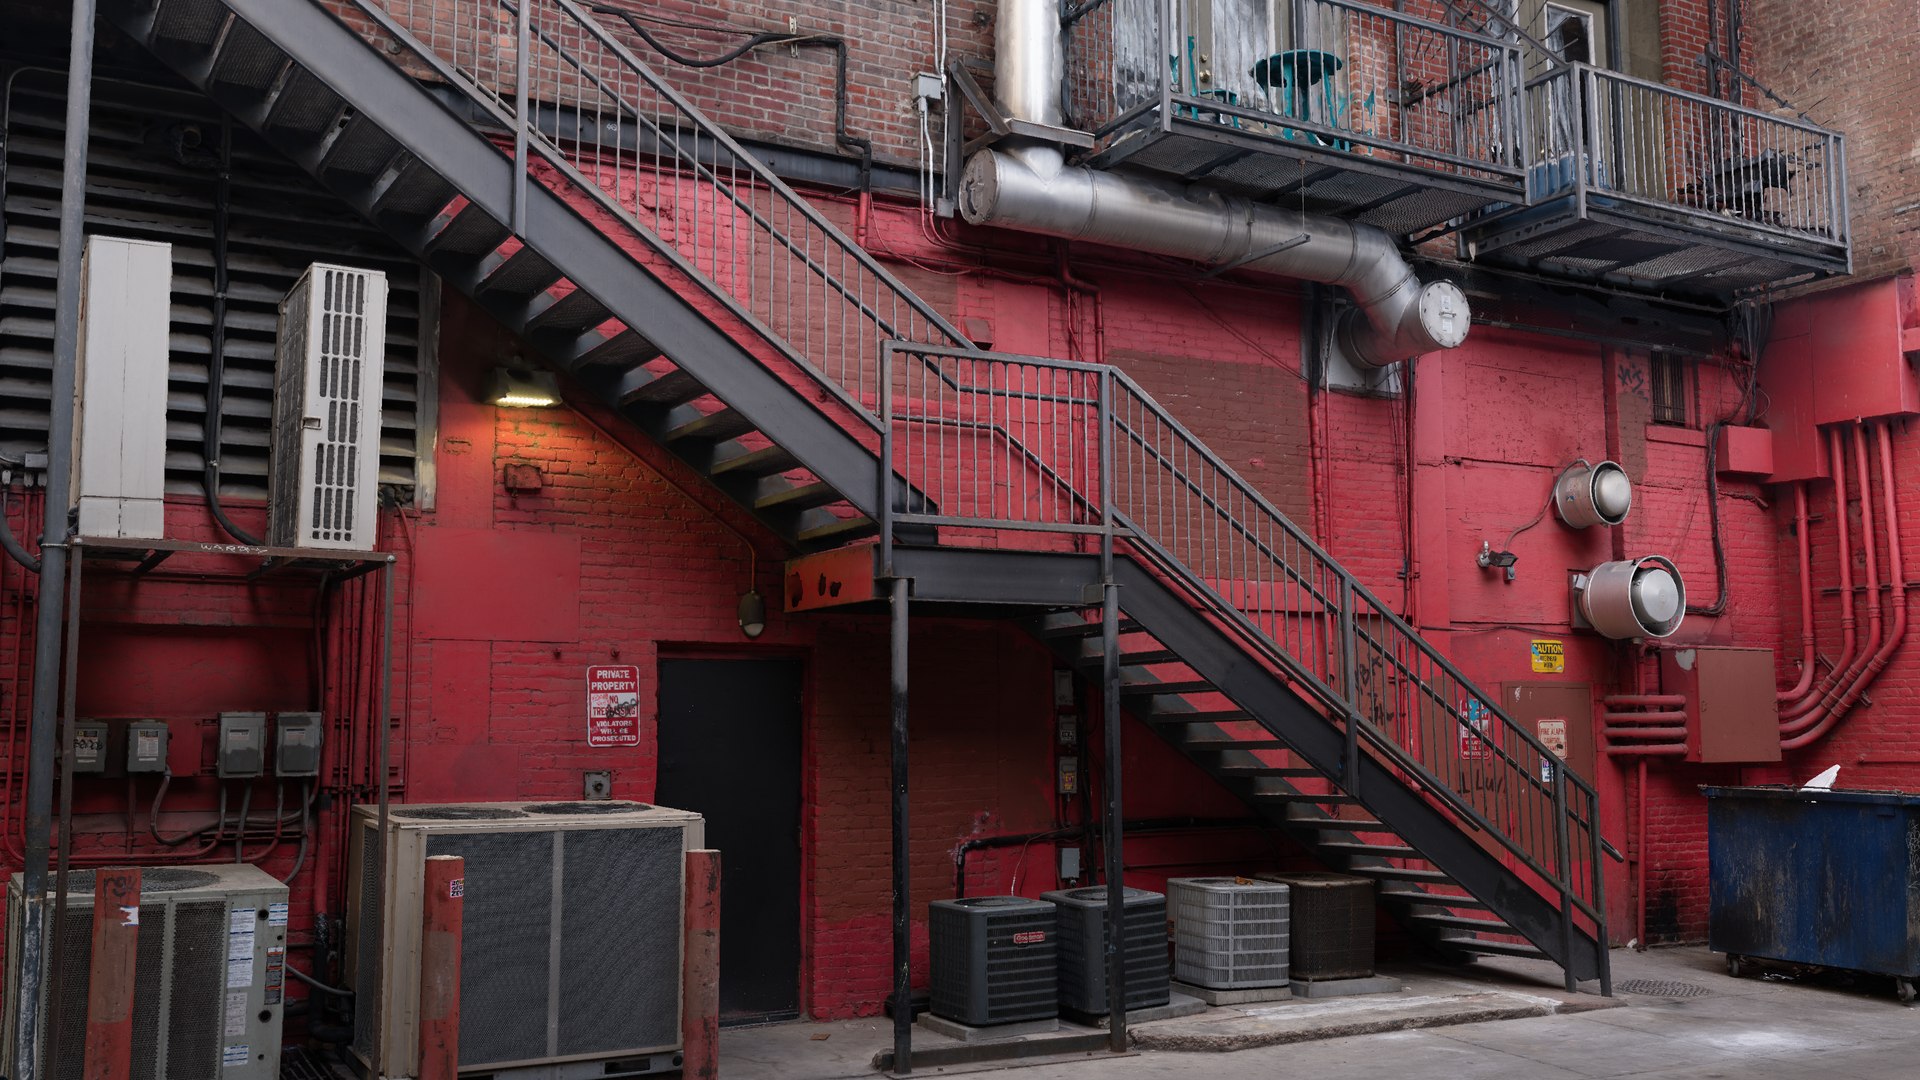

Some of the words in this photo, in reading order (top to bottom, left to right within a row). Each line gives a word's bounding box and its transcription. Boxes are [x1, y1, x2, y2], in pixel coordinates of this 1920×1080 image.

[596, 669, 630, 679] PRIVATE
[591, 681, 636, 691] PROPERTY
[609, 695, 619, 704] NO
[596, 720, 633, 728] VIOLATORS
